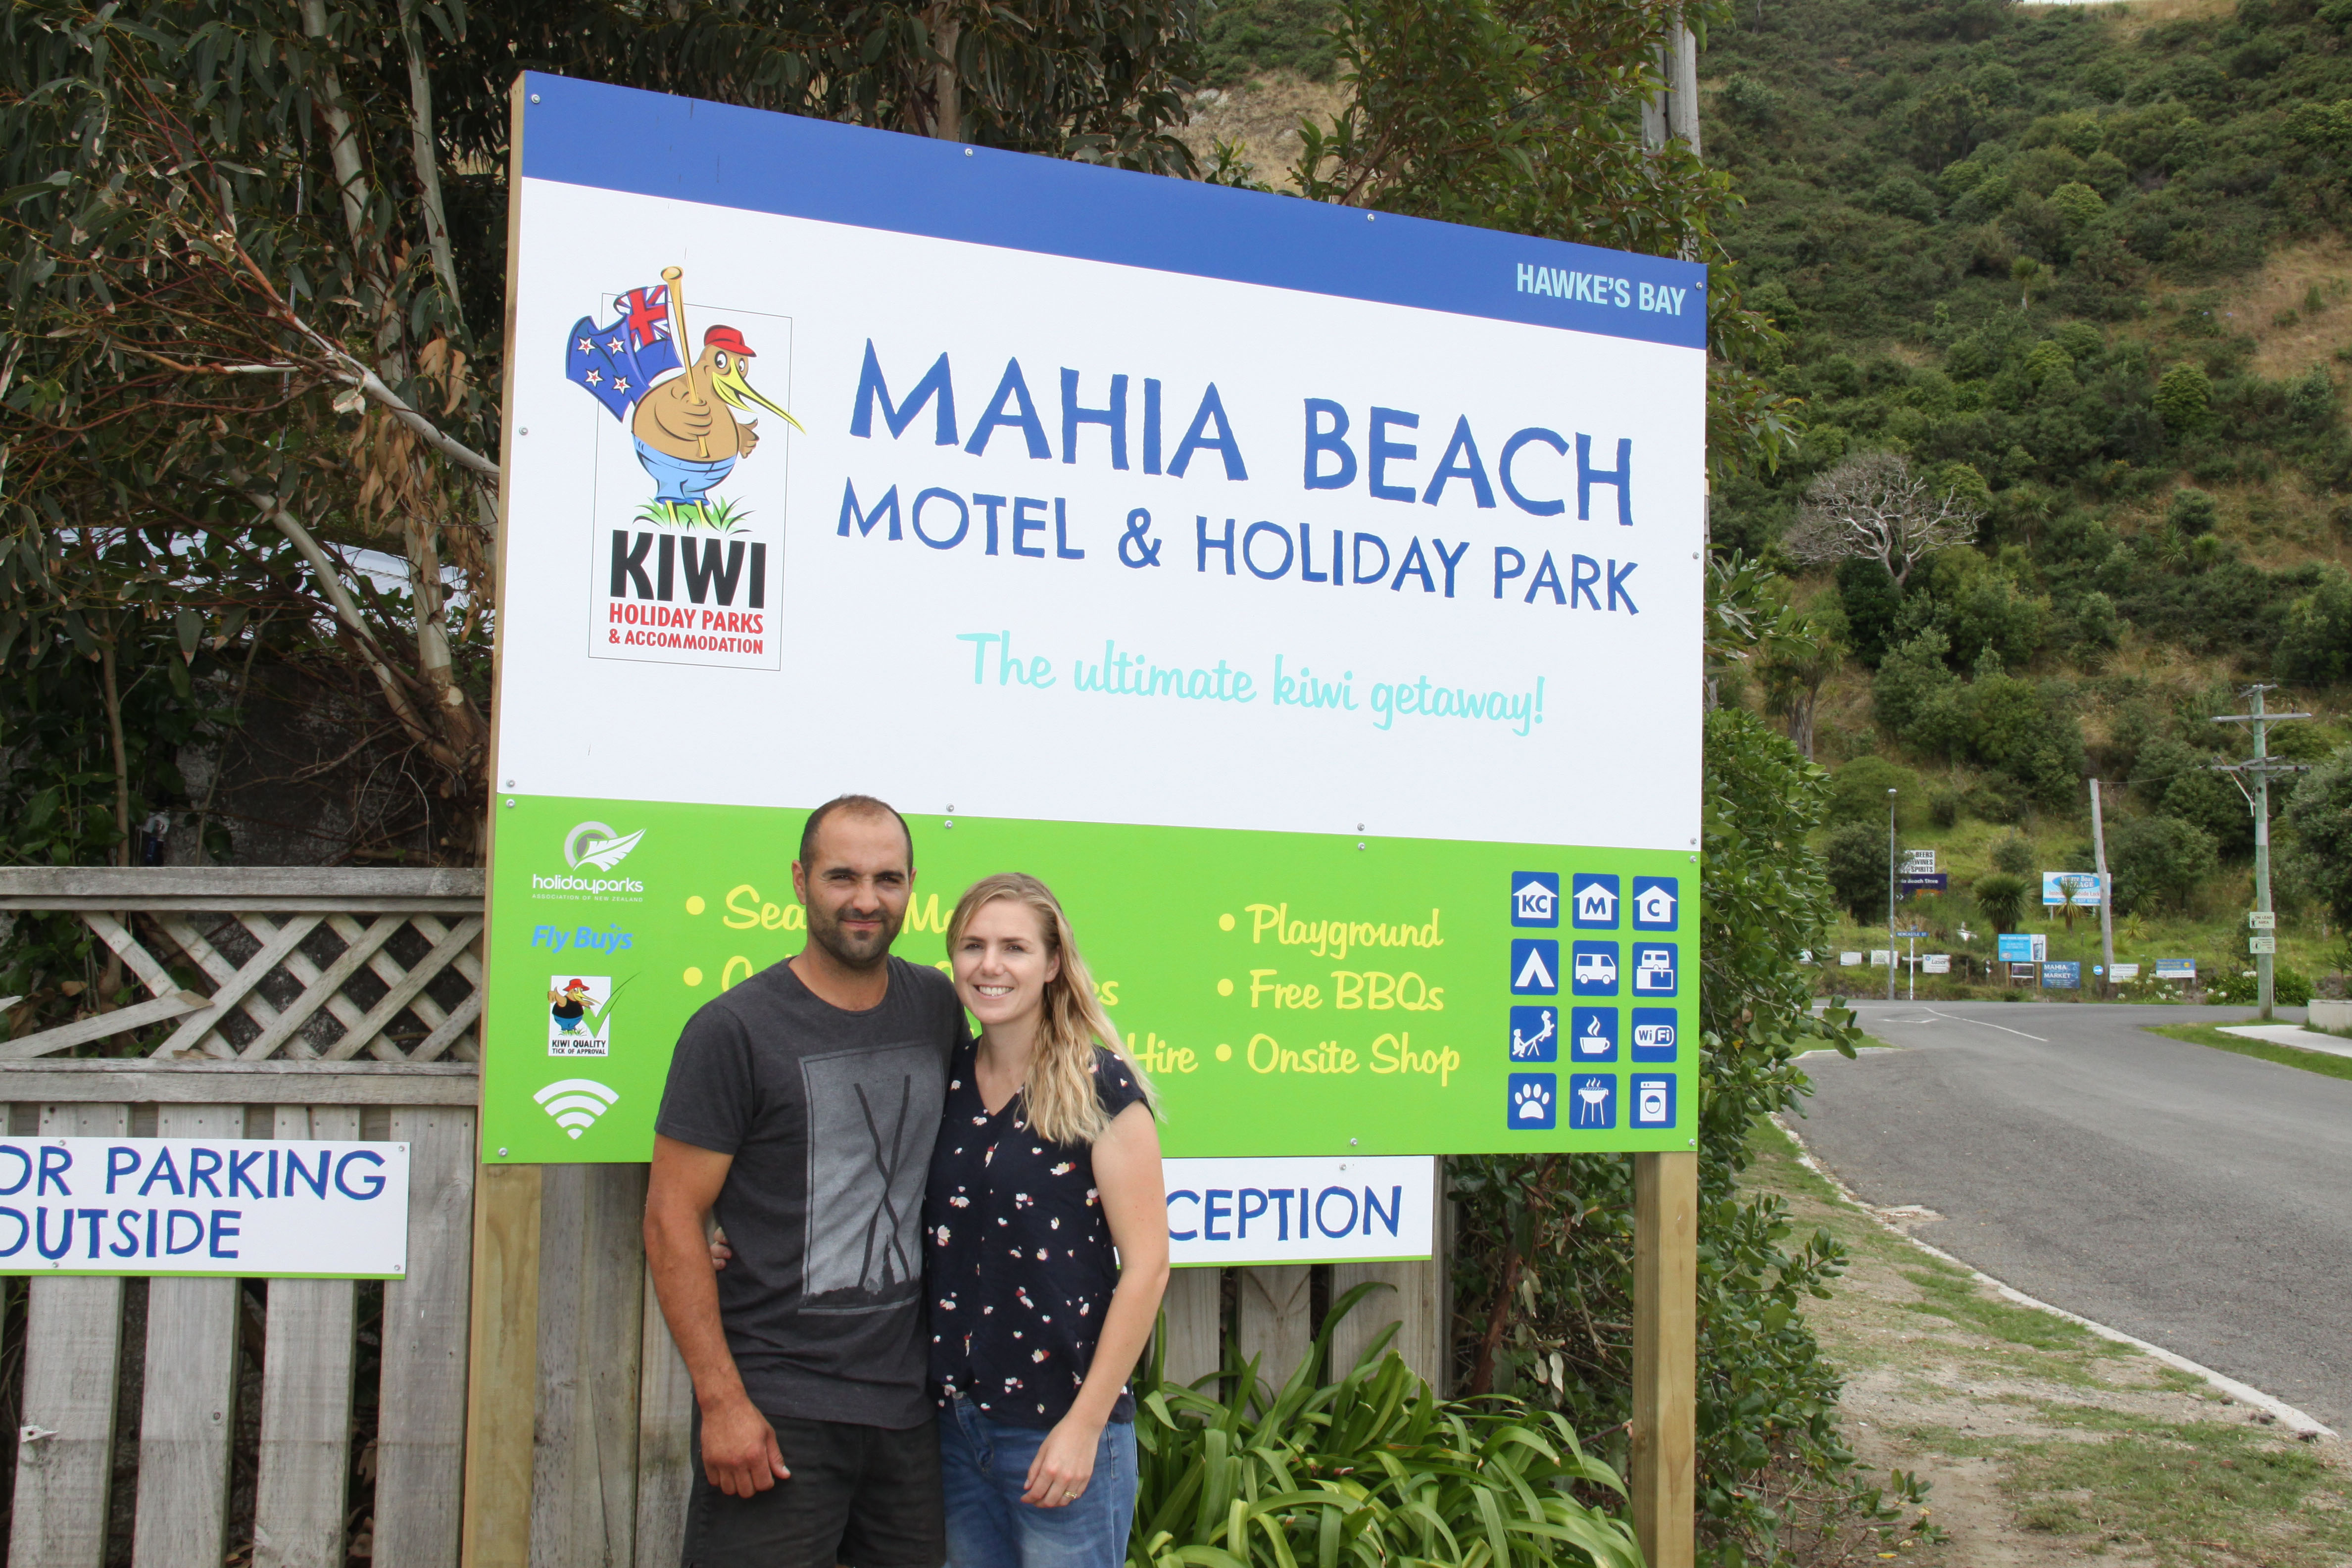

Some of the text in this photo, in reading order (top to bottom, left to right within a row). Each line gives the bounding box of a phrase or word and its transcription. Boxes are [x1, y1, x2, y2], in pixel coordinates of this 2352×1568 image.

[1517, 262, 1686, 316] HAWKE'S BAY
[849, 337, 1633, 527] MAHIA BEACH
[610, 529, 767, 609] KIWI
[836, 476, 1639, 616] MOTEL & HOLIDAY PARK
[608, 628, 763, 655] & ACCOMMODATION
[609, 602, 764, 635] HOLIDAY PARKS
[955, 630, 1546, 737] The ultimate kiwi getaway!
[532, 874, 644, 894] holidayparks
[723, 884, 807, 930] Sea
[1522, 894, 1548, 913] KC
[1585, 897, 1607, 915] M
[1244, 902, 1444, 960] Playground
[1647, 899, 1660, 917] C
[531, 923, 634, 955] Fly Buys
[1250, 969, 1444, 1011] Free BBQs
[573, 1039, 606, 1048] QUALITY
[1127, 1032, 1199, 1074] Hire
[1247, 1031, 1461, 1087] Onsite Shop
[105, 1145, 387, 1201] PARKING
[0, 1206, 243, 1260] OUTSIDE
[1166, 1185, 1402, 1242] CEPTION
